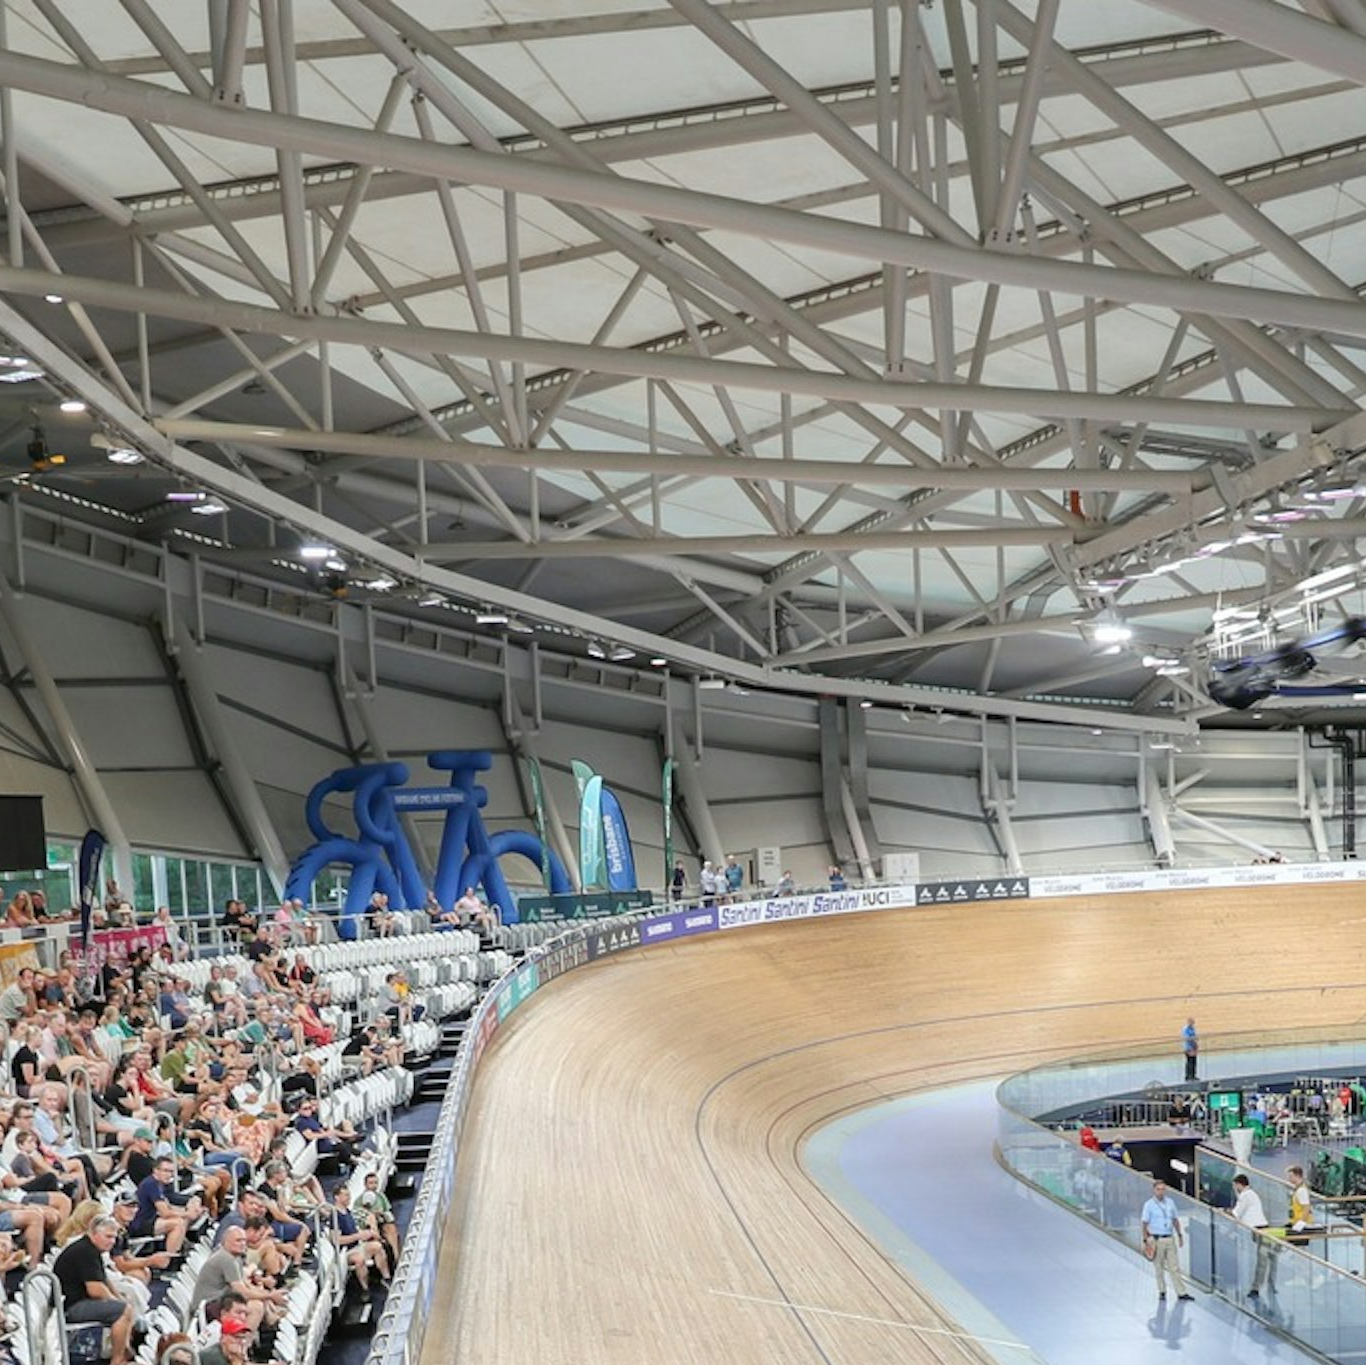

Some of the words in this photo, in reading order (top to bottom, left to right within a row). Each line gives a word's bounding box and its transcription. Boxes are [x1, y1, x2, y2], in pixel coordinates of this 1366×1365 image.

[602, 815, 623, 874] brisbane
[764, 897, 810, 919] Santini
[813, 891, 860, 913] Santini
[867, 892, 891, 907] UCI
[720, 902, 762, 926] Santini
